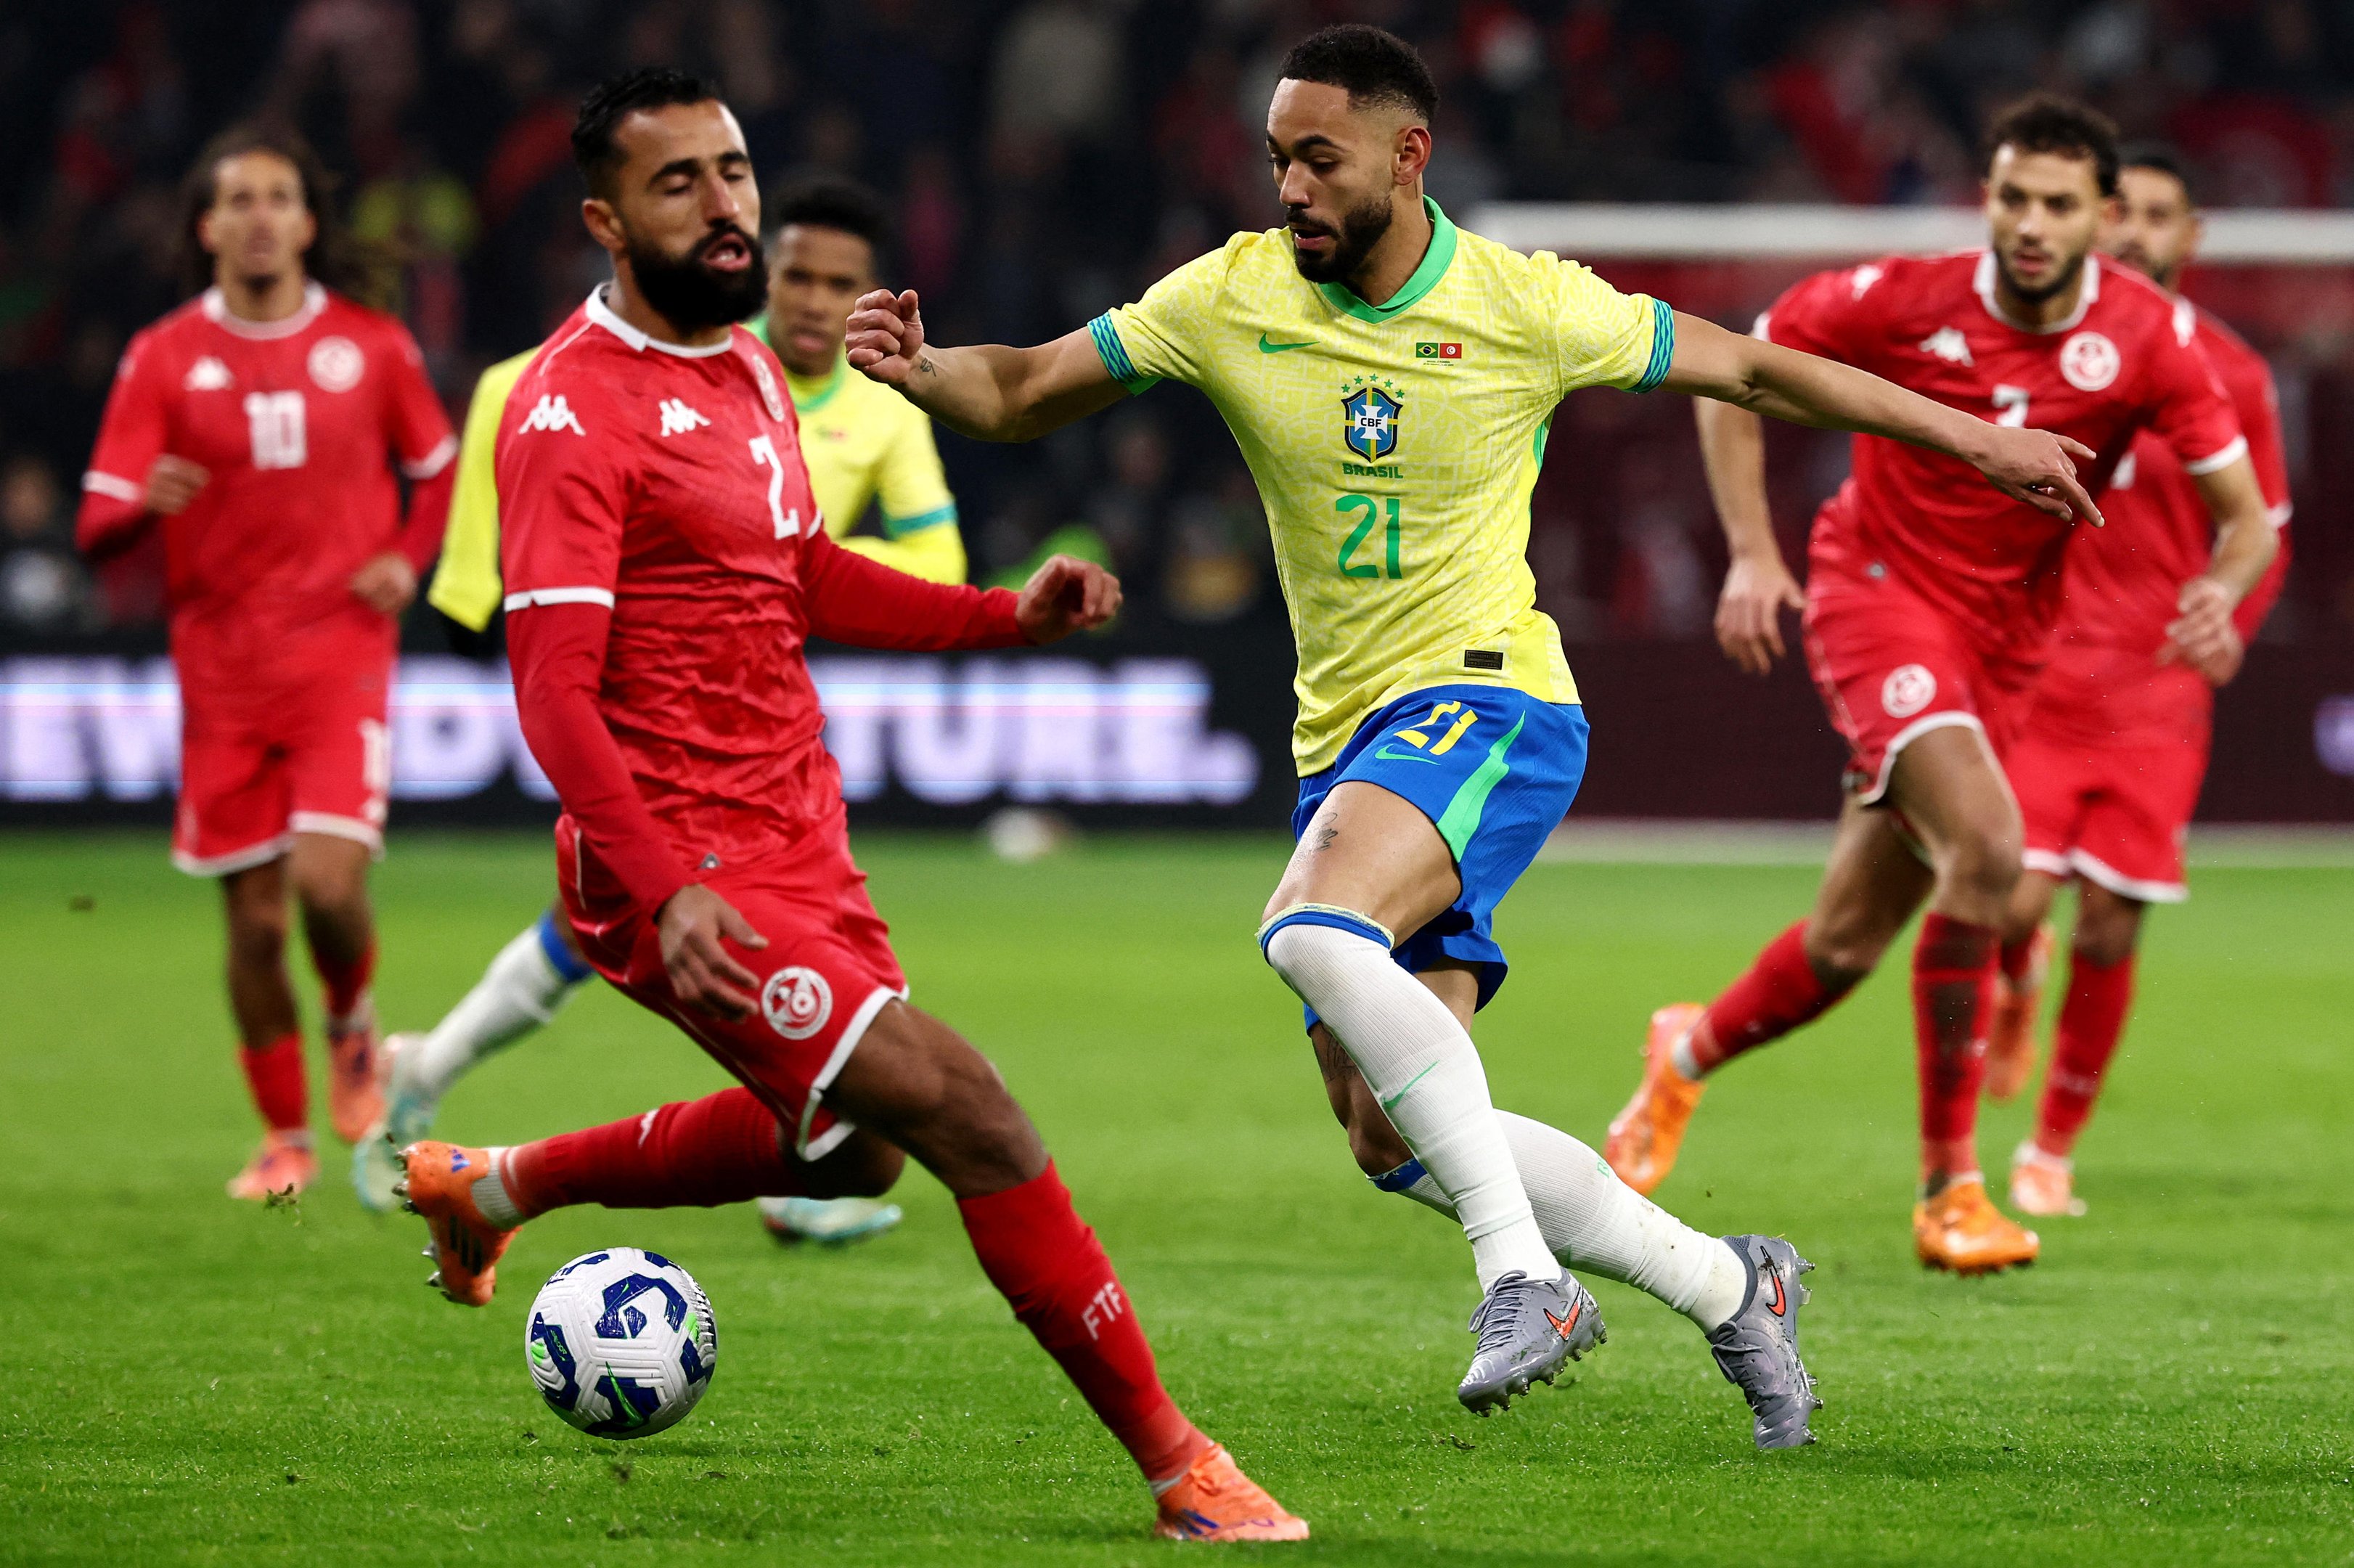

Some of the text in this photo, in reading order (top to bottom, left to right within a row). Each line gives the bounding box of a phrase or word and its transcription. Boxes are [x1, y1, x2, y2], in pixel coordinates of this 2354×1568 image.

[242, 389, 308, 470] 10
[1360, 417, 1382, 428] CBF
[748, 435, 800, 539] 2
[1342, 463, 1404, 479] BRASIL
[1335, 494, 1403, 579] 21
[1393, 701, 1479, 756] 21
[1081, 1281, 1123, 1342] FTF
